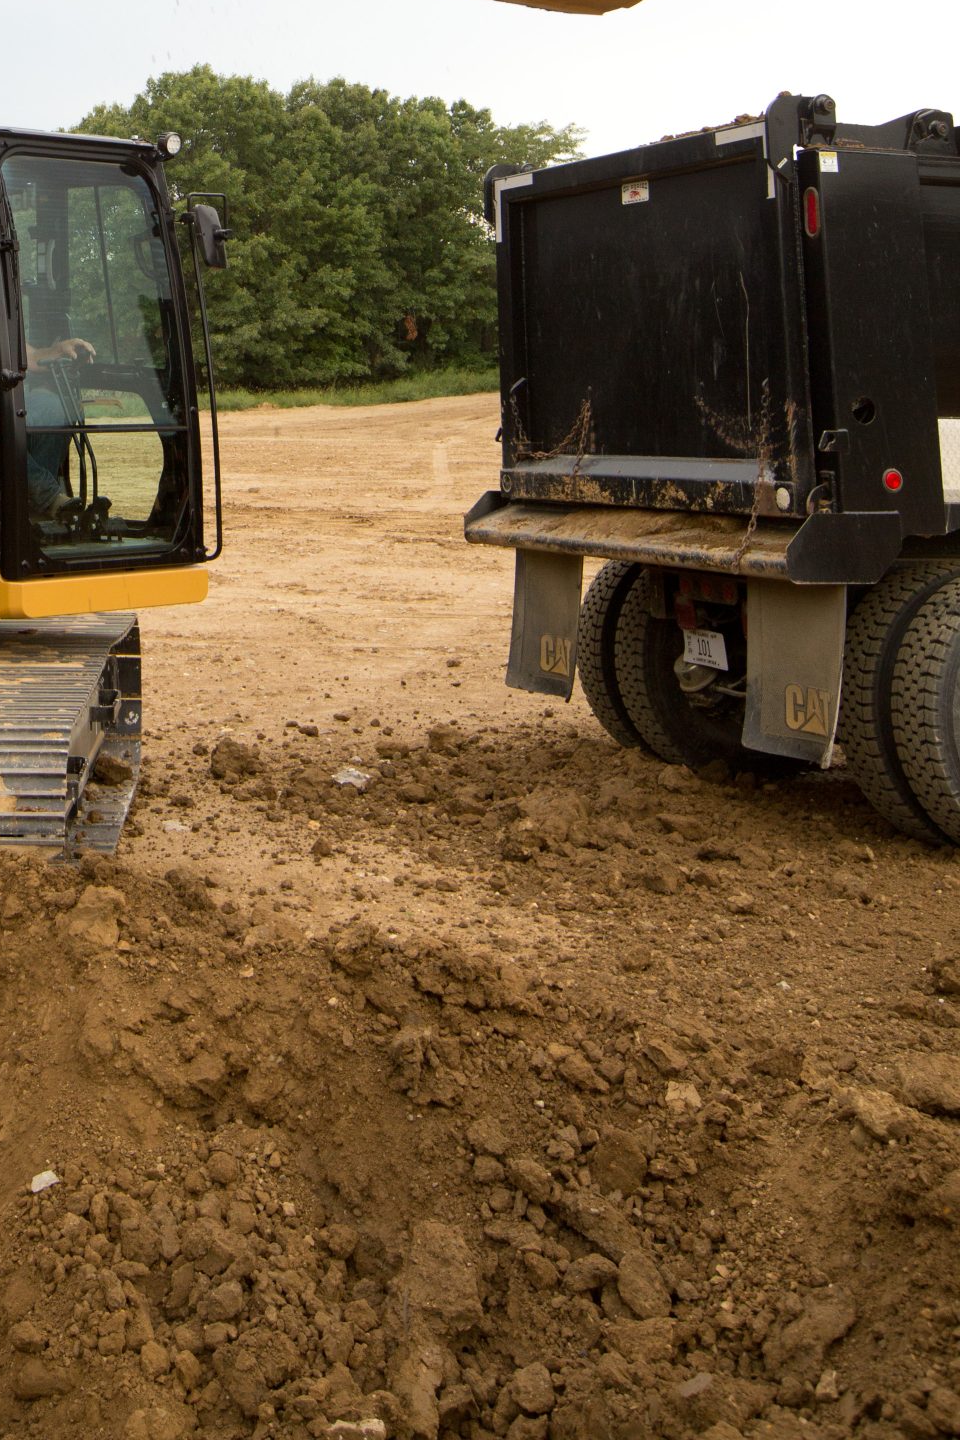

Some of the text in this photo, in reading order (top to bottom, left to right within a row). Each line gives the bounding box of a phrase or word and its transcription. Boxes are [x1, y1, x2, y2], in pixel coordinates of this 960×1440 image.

[540, 634, 571, 677] CAT
[697, 638, 712, 657] 101
[785, 684, 831, 737] CAT
